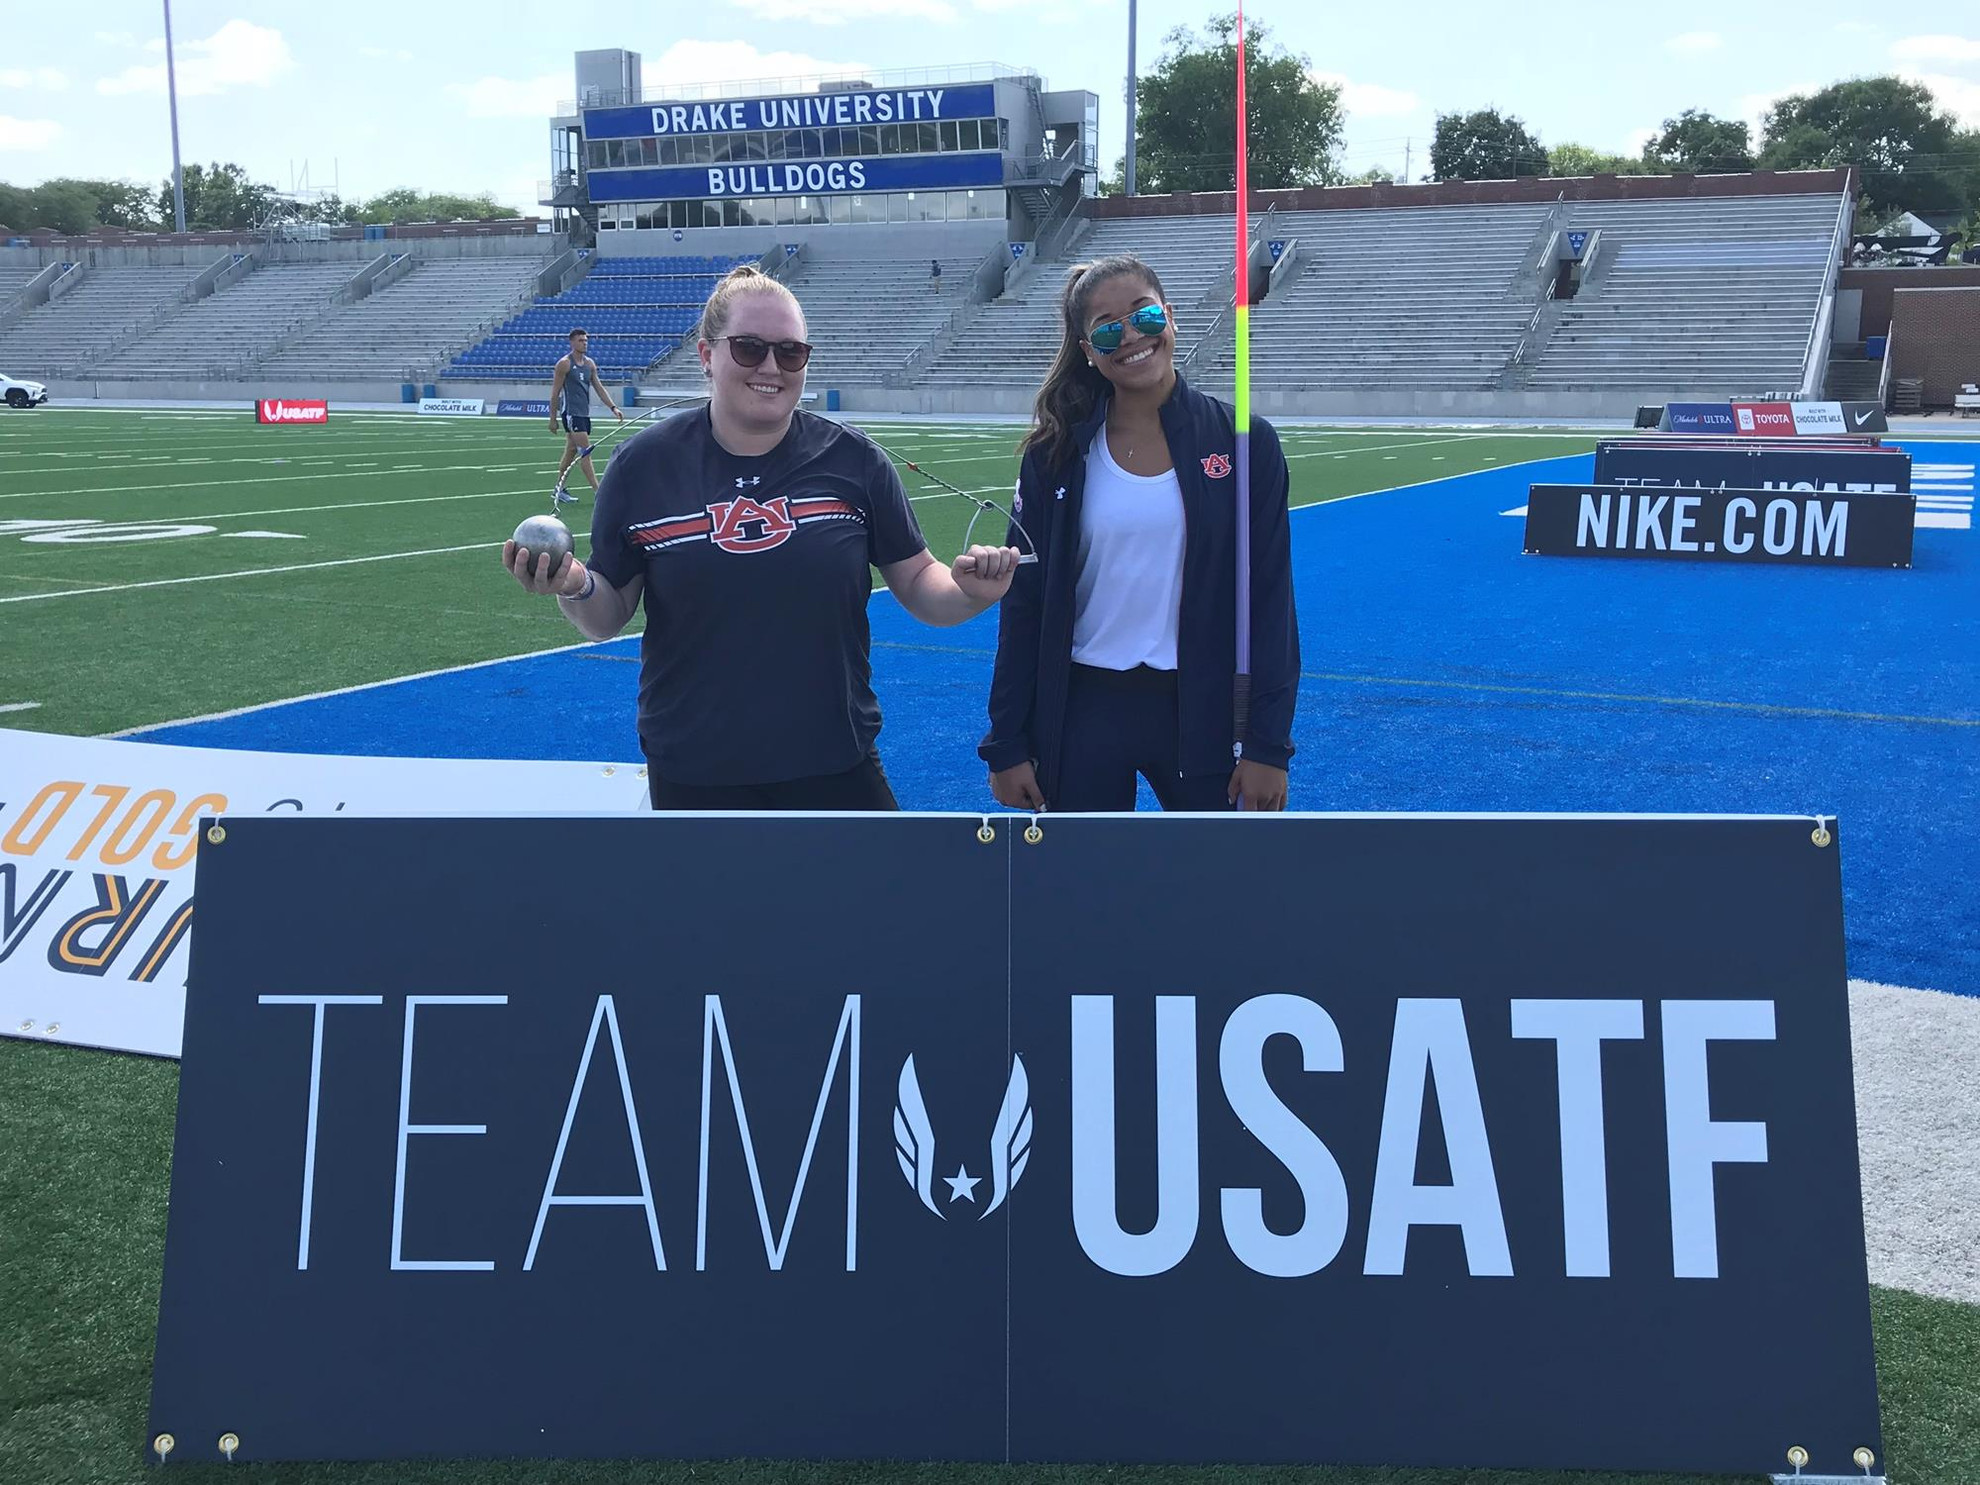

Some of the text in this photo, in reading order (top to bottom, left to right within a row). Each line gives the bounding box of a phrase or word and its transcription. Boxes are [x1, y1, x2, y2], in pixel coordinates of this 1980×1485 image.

[652, 90, 944, 134] DRAKE UNIVERSITY
[707, 161, 866, 196] BULLDOGS
[282, 407, 326, 419] USATF
[423, 404, 461, 412] CHOCOLATE
[1703, 415, 1732, 424] ULTRA
[1755, 414, 1791, 424] TOYOTA
[1795, 415, 1829, 424] CHOCOLATE
[1576, 493, 1850, 557] NIKE.COM
[1, 780, 228, 871] GOLD
[258, 993, 1777, 1280] TEAM USATF
